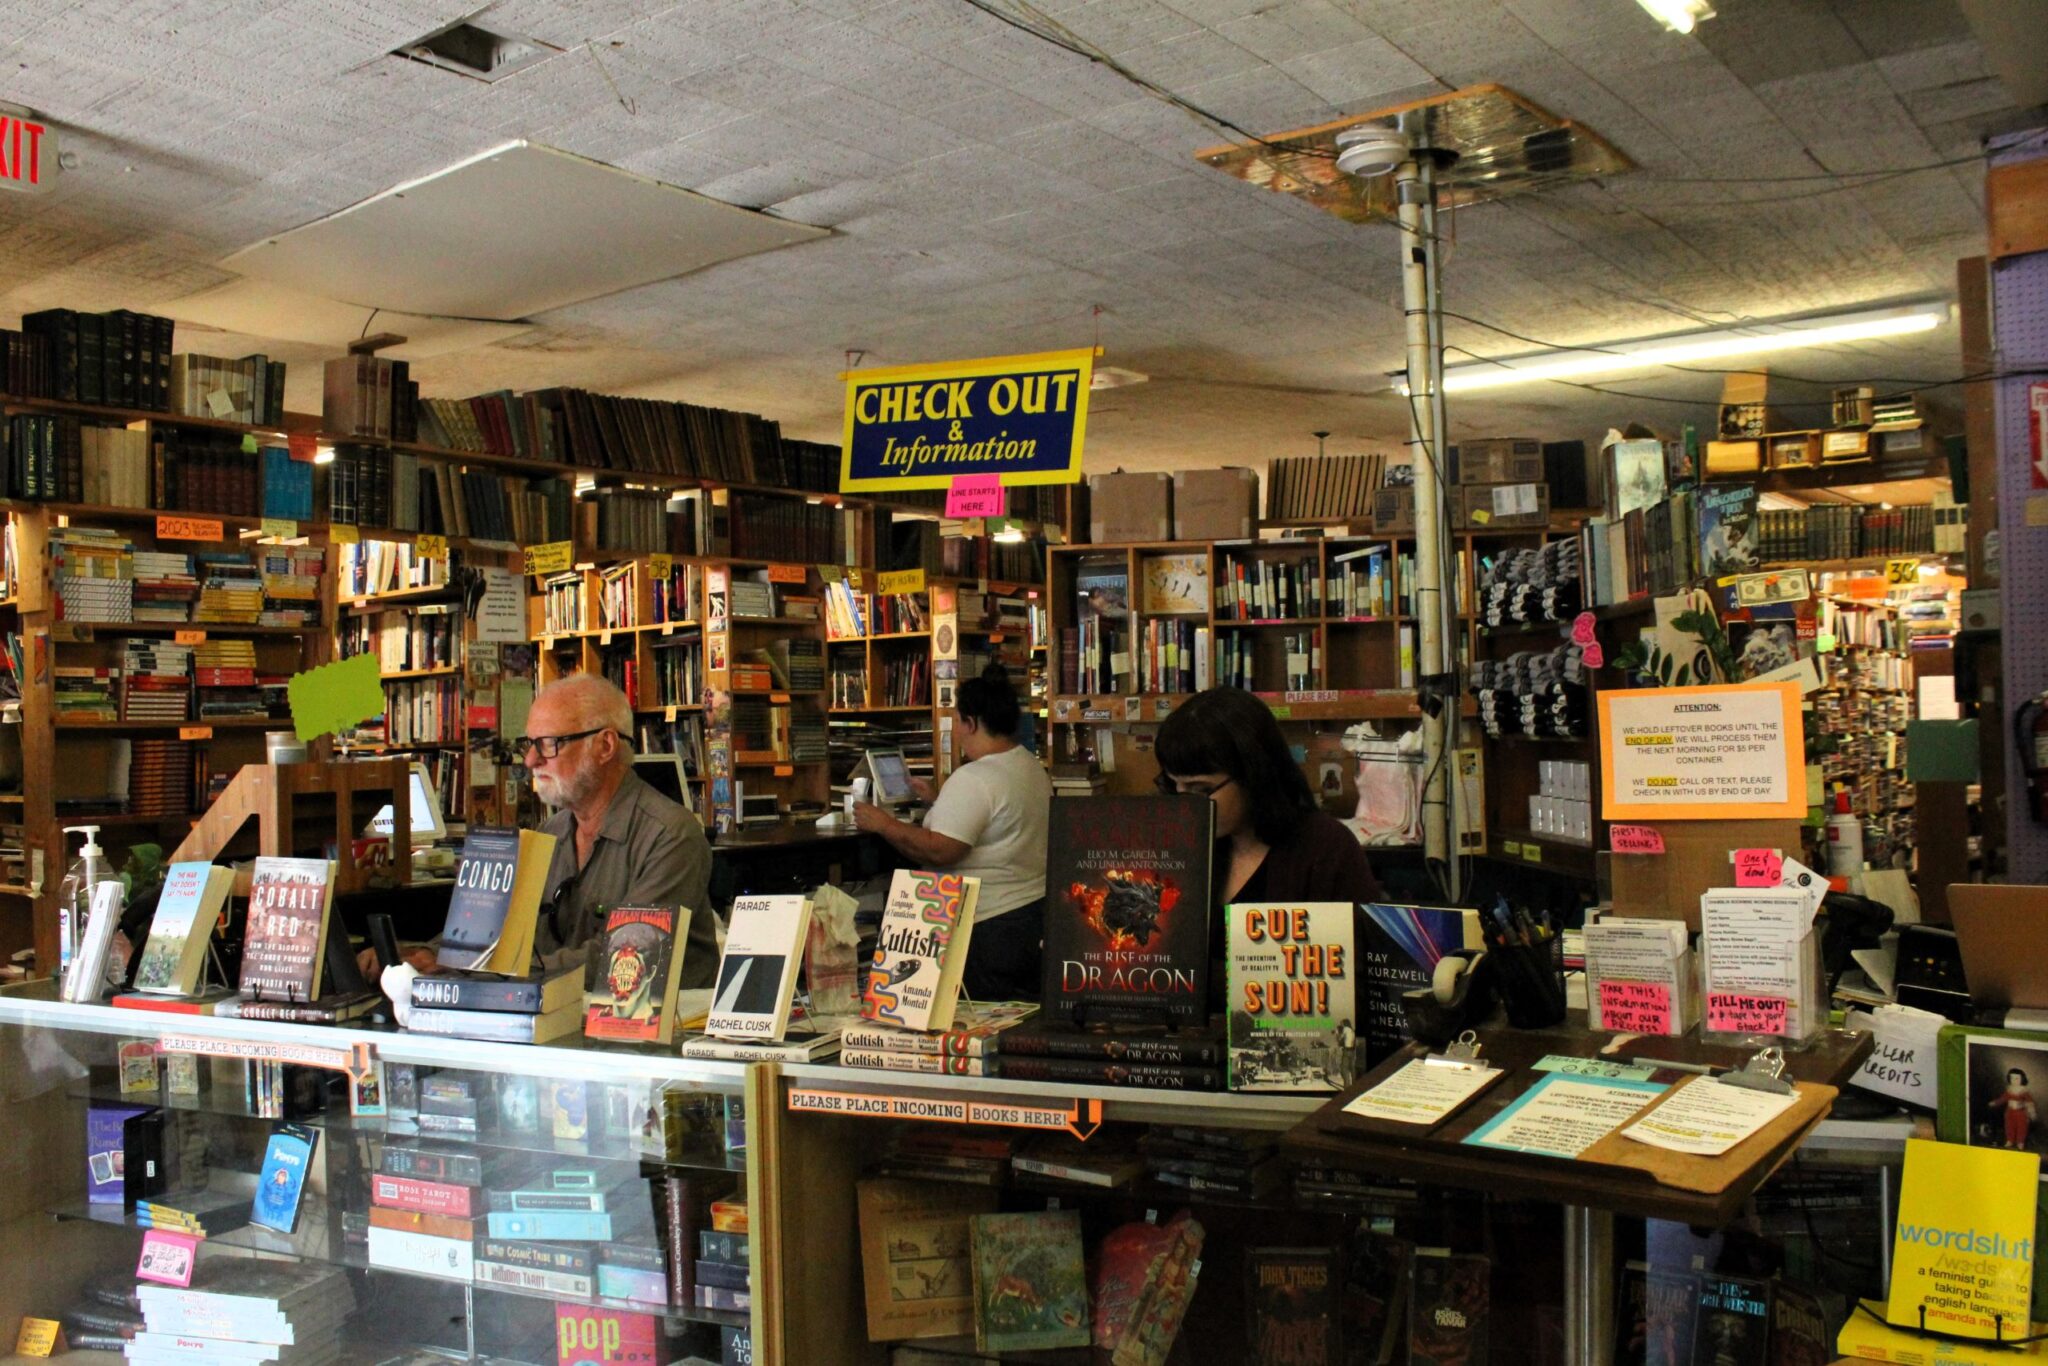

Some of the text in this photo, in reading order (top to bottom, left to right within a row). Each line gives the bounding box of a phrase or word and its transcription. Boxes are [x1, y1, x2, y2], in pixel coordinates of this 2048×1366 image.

[855, 373, 1078, 424] CHECK OUT
[948, 420, 964, 441] &
[880, 431, 1037, 476] Information
[951, 488, 996, 497] LINE STARTS
[961, 502, 984, 511] HERE
[158, 520, 191, 537] 2023
[419, 538, 443, 555] 5A
[651, 558, 670, 578] 5B
[1673, 703, 1722, 712] ATTENTION:
[1661, 725, 1702, 733] LEFTOVER
[1761, 722, 1778, 730] THE
[1626, 733, 1777, 745] END OF WE WILL PROCESS THEM
[1654, 746, 1674, 754] NEXT
[1677, 745, 1715, 753] MORNING
[1647, 778, 1659, 786] DO
[1660, 778, 1677, 786] NOT
[1679, 777, 1700, 785] CALL
[1740, 776, 1773, 784] PLEASE
[1632, 788, 1661, 796] CHECK
[1721, 787, 1739, 795] END
[1076, 860, 1097, 869] AND
[457, 859, 514, 893] CONGO
[255, 885, 320, 910] COBALT
[900, 890, 909, 898] The
[735, 901, 772, 911] PARADE
[891, 898, 914, 910] Language
[891, 909, 917, 920] Fanaticism
[266, 914, 299, 938] RED
[1245, 908, 1310, 942] CUE
[879, 924, 941, 958] Cultish
[1083, 951, 1171, 964] THE RISE OF THE
[1280, 944, 1345, 978] THE
[1366, 951, 1389, 963] RAY
[1062, 960, 1197, 993] DRAGON
[1367, 967, 1429, 982] KURZWEIL
[418, 982, 460, 1004] CONGO
[901, 983, 932, 998] Amanda
[1244, 980, 1328, 1014] SUN!
[1600, 984, 1623, 995] TAKE
[900, 995, 929, 1010] Montell
[1710, 995, 1738, 1007] FILL
[1739, 997, 1755, 1009] ME
[243, 1007, 296, 1020] COBALT RED
[1604, 1009, 1661, 1024] ABOUT OUR
[1752, 1011, 1761, 1019] to
[708, 1018, 772, 1032] RACHEL CUSK
[164, 1038, 277, 1057] PLEASE PLACE INCOMING
[845, 1032, 884, 1048] Cultish
[1141, 1042, 1159, 1051] RISE
[686, 1048, 788, 1061] PARADE RACHEL CUSK
[845, 1052, 884, 1068] Cultish
[1126, 1050, 1183, 1062] DRAGON
[1142, 1067, 1159, 1076] RISE
[1864, 1060, 1922, 1087] CREDITS
[1127, 1075, 1184, 1087] DRAGON
[792, 1094, 1068, 1126] PLEASE PLACE INCOMING BOOKS HERE!
[399, 1184, 452, 1199] ROSE TAROT
[1899, 1223, 2033, 1262] wordslut
[506, 1245, 551, 1262] COSMIC TRIBE
[522, 1270, 545, 1290] TAROT
[1917, 1267, 1926, 1275] a
[1929, 1267, 1976, 1285] feminist
[1935, 1282, 1971, 1299] taking
[1923, 1294, 1967, 1310] english
[1927, 1308, 1976, 1324] amanda
[560, 1316, 622, 1361] pop
